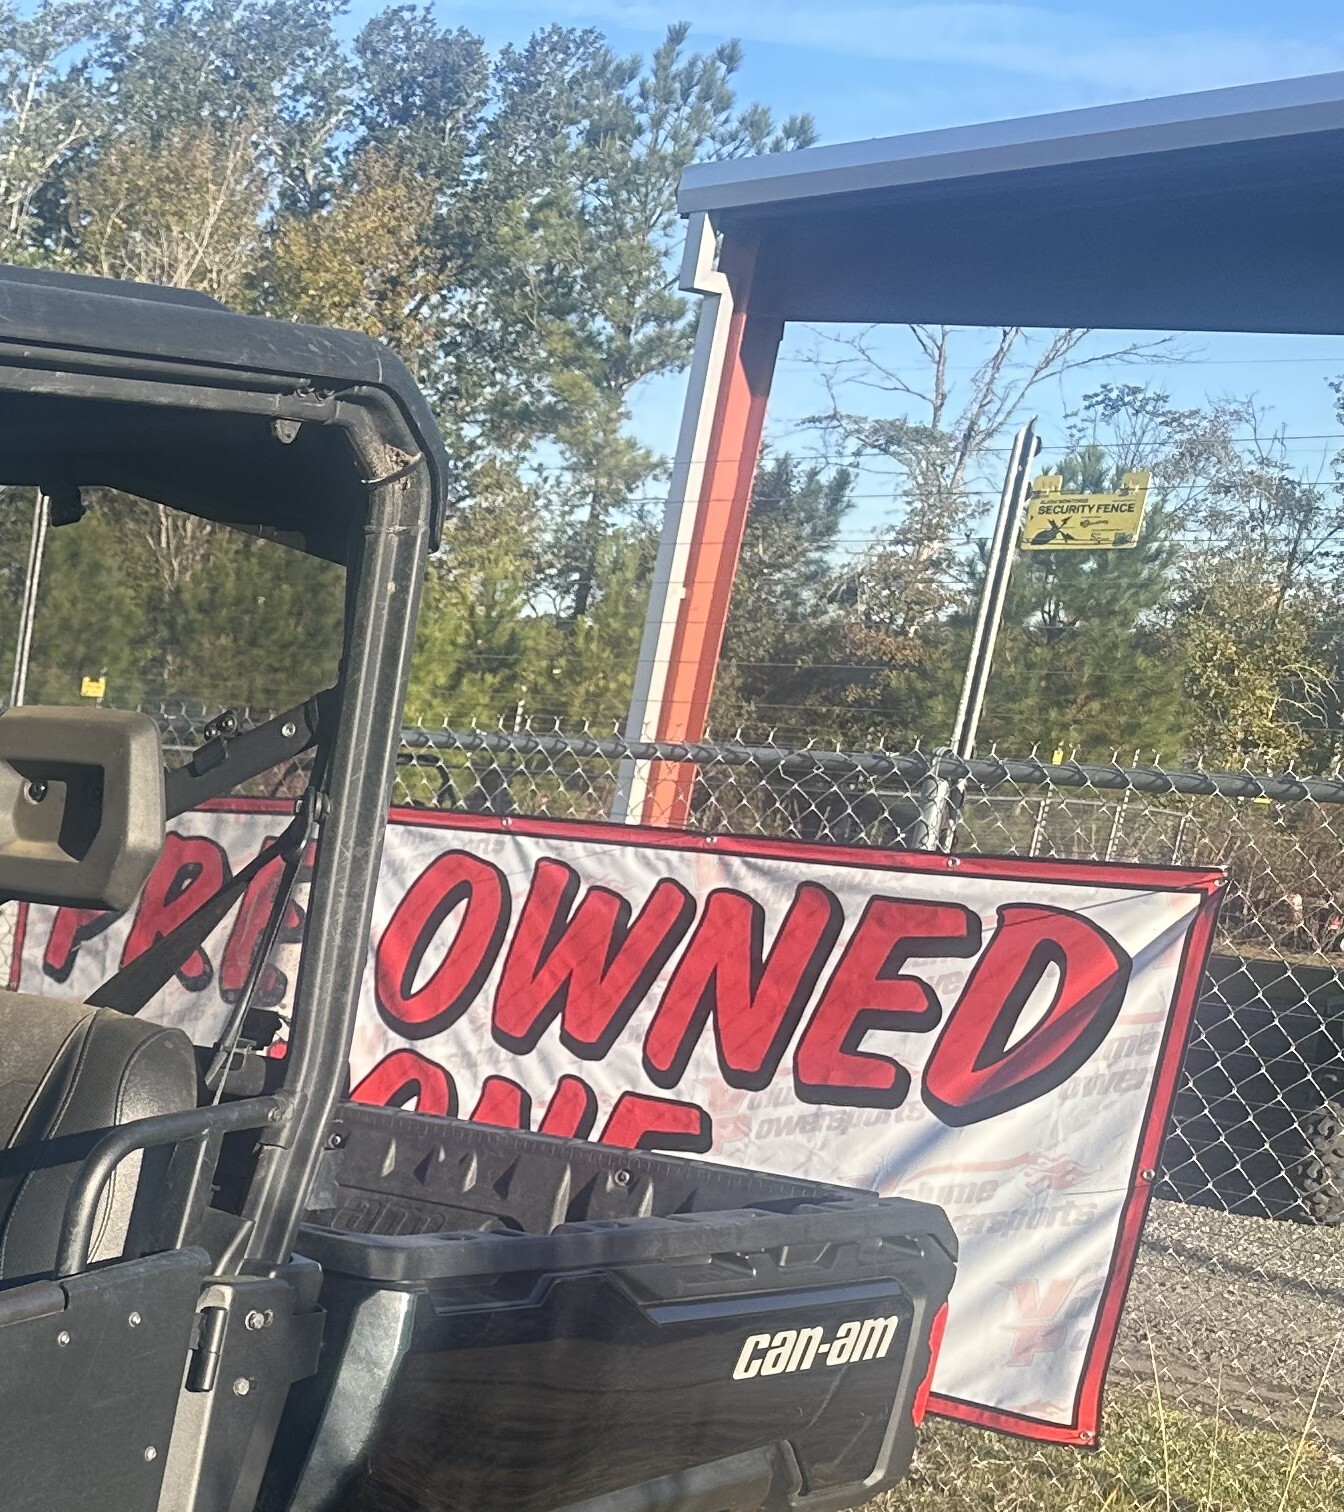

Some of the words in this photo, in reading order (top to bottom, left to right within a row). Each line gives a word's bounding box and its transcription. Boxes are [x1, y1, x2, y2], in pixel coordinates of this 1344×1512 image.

[1038, 503, 1096, 515] SECURITY
[1096, 502, 1135, 513] FENCE
[374, 848, 1132, 1127] OWNED
[732, 1315, 899, 1381] can-am
